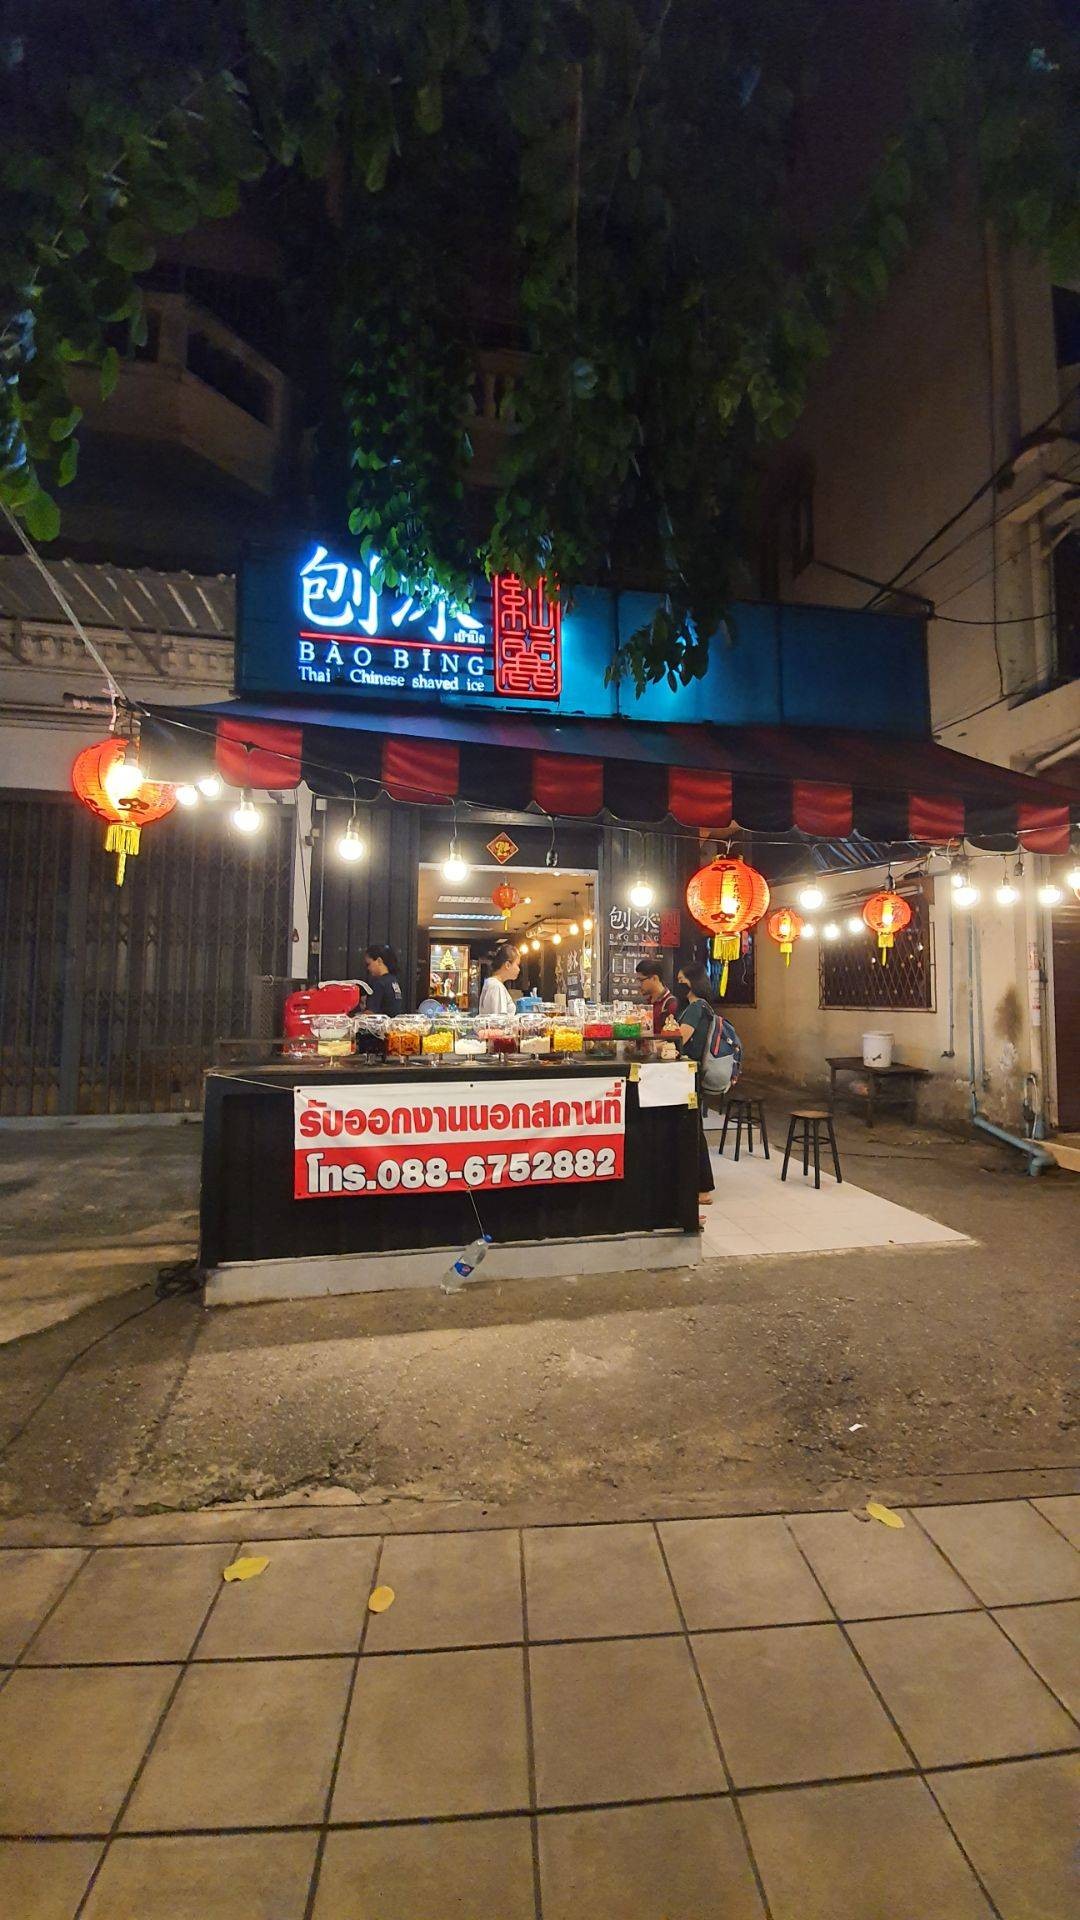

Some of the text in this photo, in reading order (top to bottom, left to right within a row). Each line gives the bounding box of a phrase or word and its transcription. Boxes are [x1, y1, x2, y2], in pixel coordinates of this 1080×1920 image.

[299, 666, 485, 692] Thai Chinese shaved ice
[609, 905, 660, 932] 刨冰
[300, 1082, 621, 1138] รับออกงานนอกสถานที่
[306, 1148, 616, 1194] โทร.088-6752882
